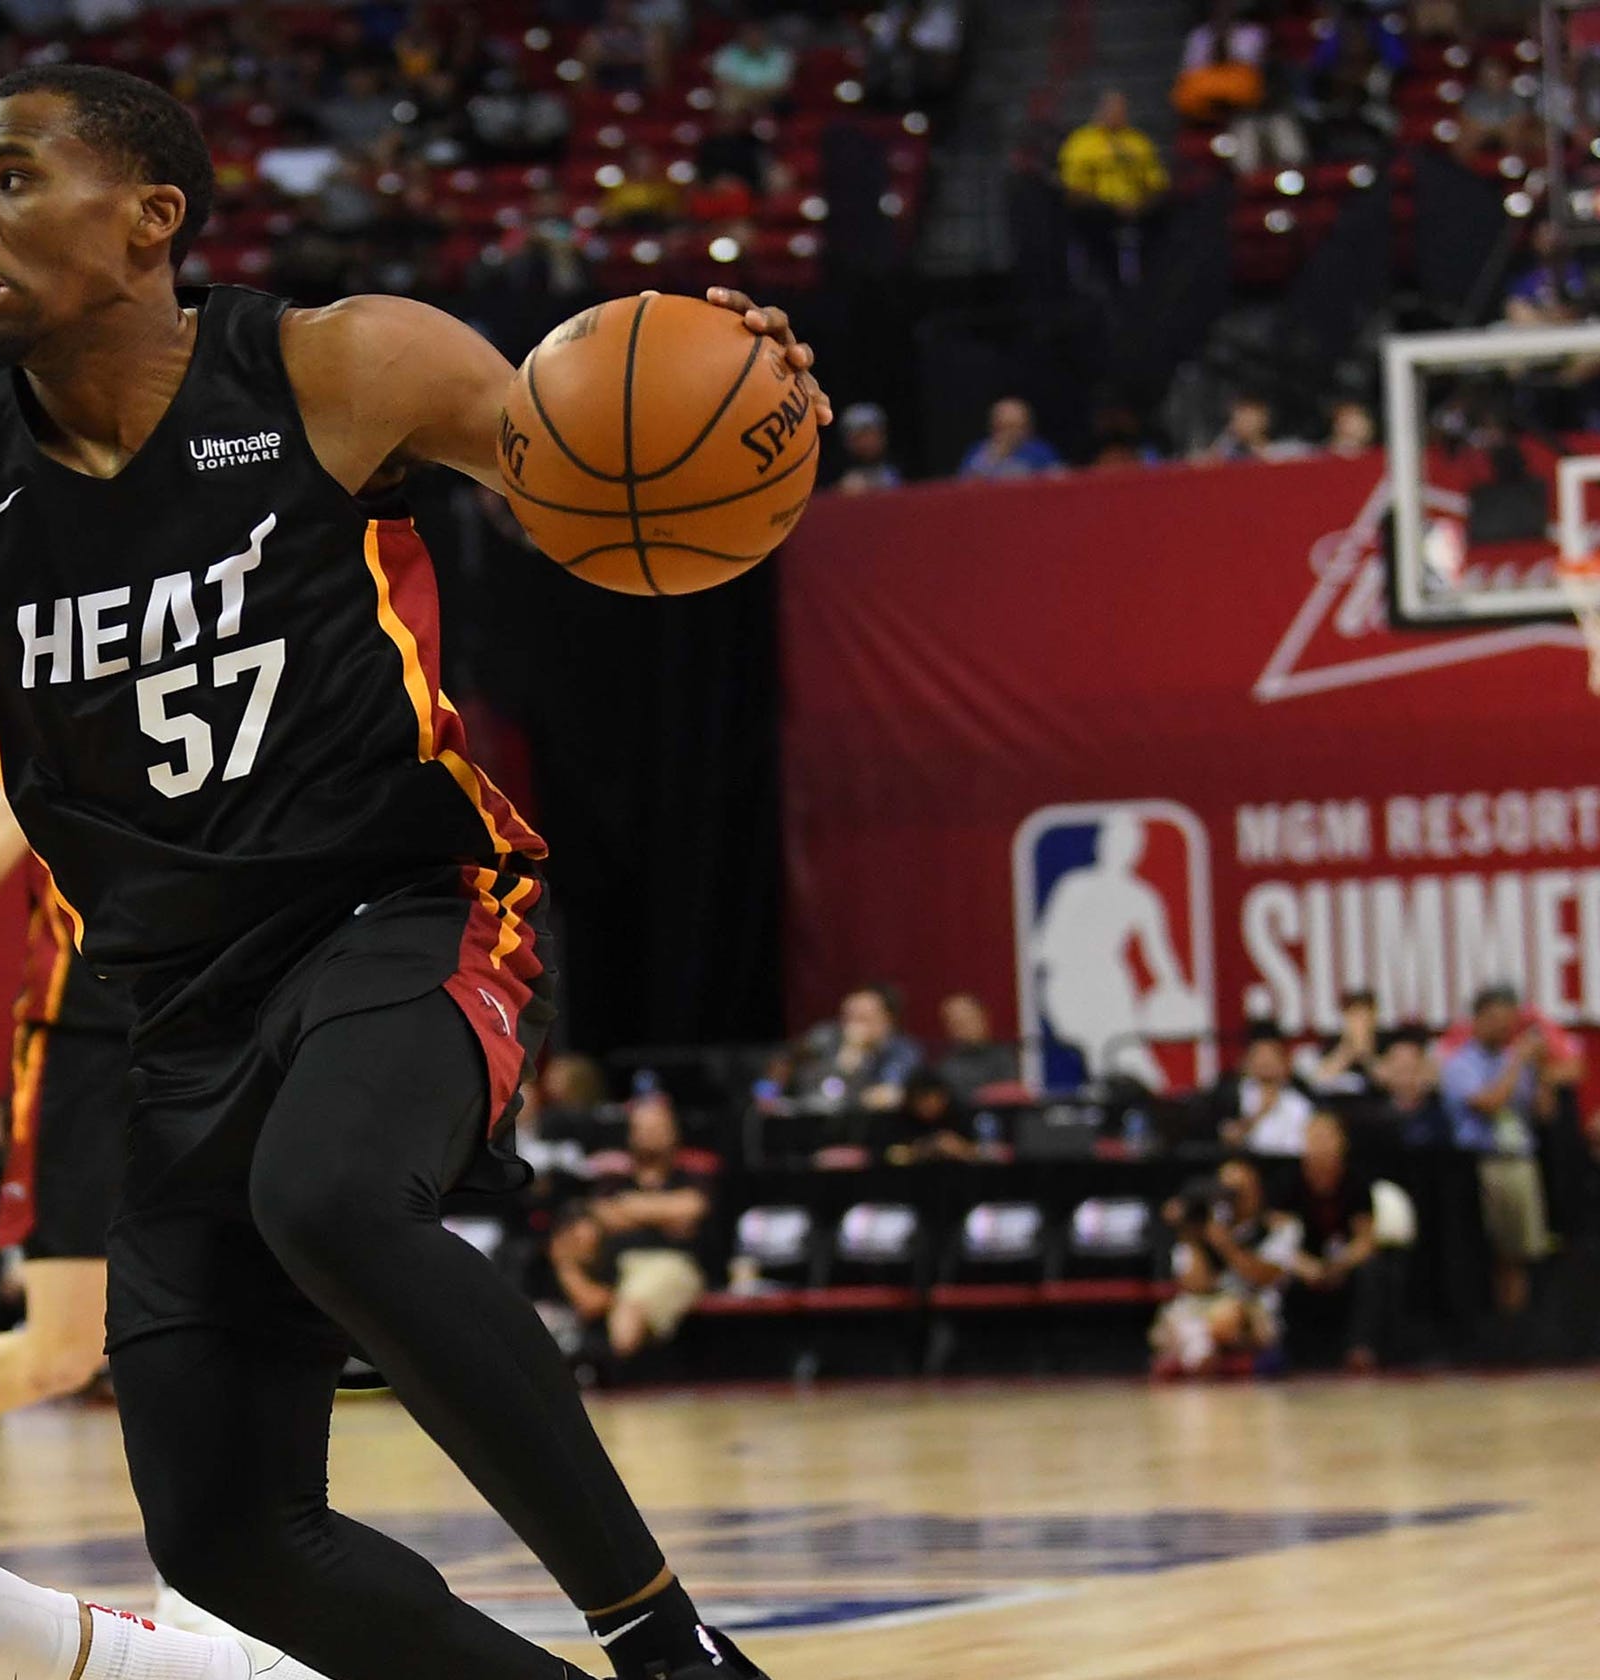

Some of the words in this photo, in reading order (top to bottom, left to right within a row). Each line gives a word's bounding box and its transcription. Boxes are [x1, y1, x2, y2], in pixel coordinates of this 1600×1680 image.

[189, 431, 281, 460] Ultimate
[196, 448, 280, 471] SOFTWARE
[17, 512, 277, 688] HEAT
[136, 638, 285, 798] 57
